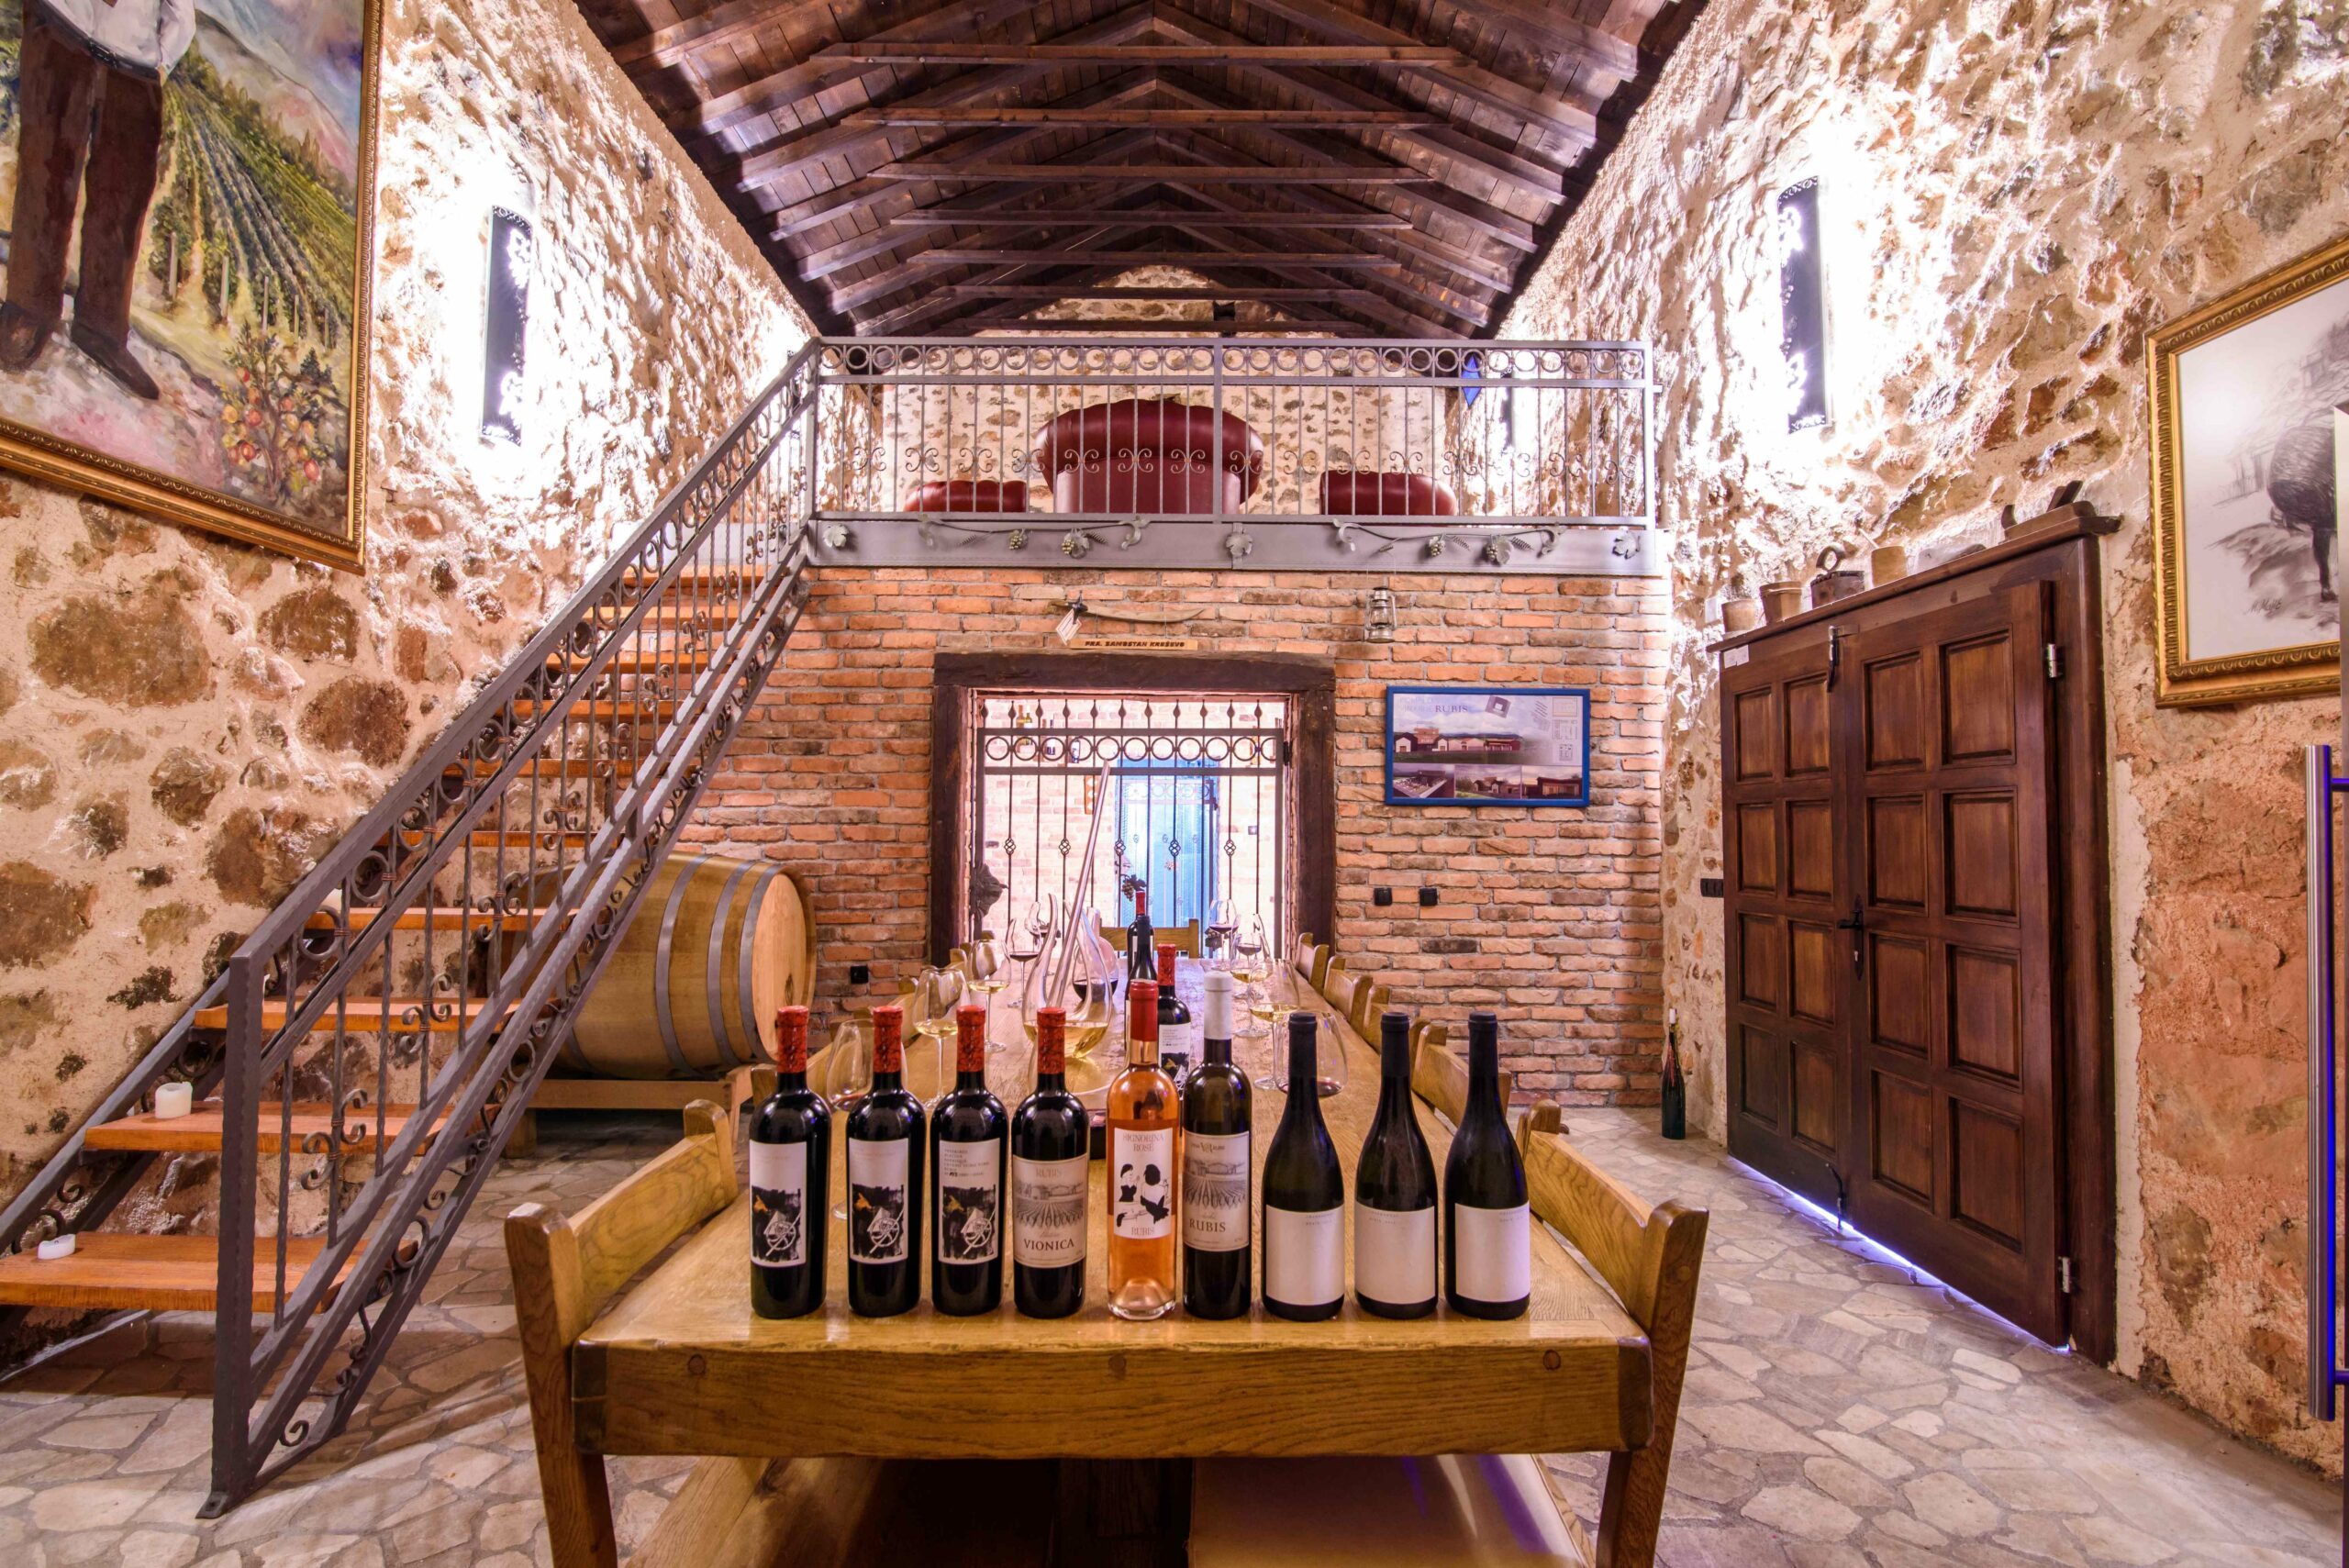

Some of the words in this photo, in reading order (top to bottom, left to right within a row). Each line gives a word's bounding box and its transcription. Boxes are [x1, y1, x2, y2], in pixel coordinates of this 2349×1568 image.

[1435, 705, 1469, 713] RUBIS
[1122, 1132, 1164, 1144] SIGNORINA
[1035, 1167, 1062, 1178] RUBIS
[1189, 1218, 1226, 1232] RUBIS
[1131, 1227, 1155, 1236] RUBIS
[1023, 1238, 1074, 1251] VIONICA
